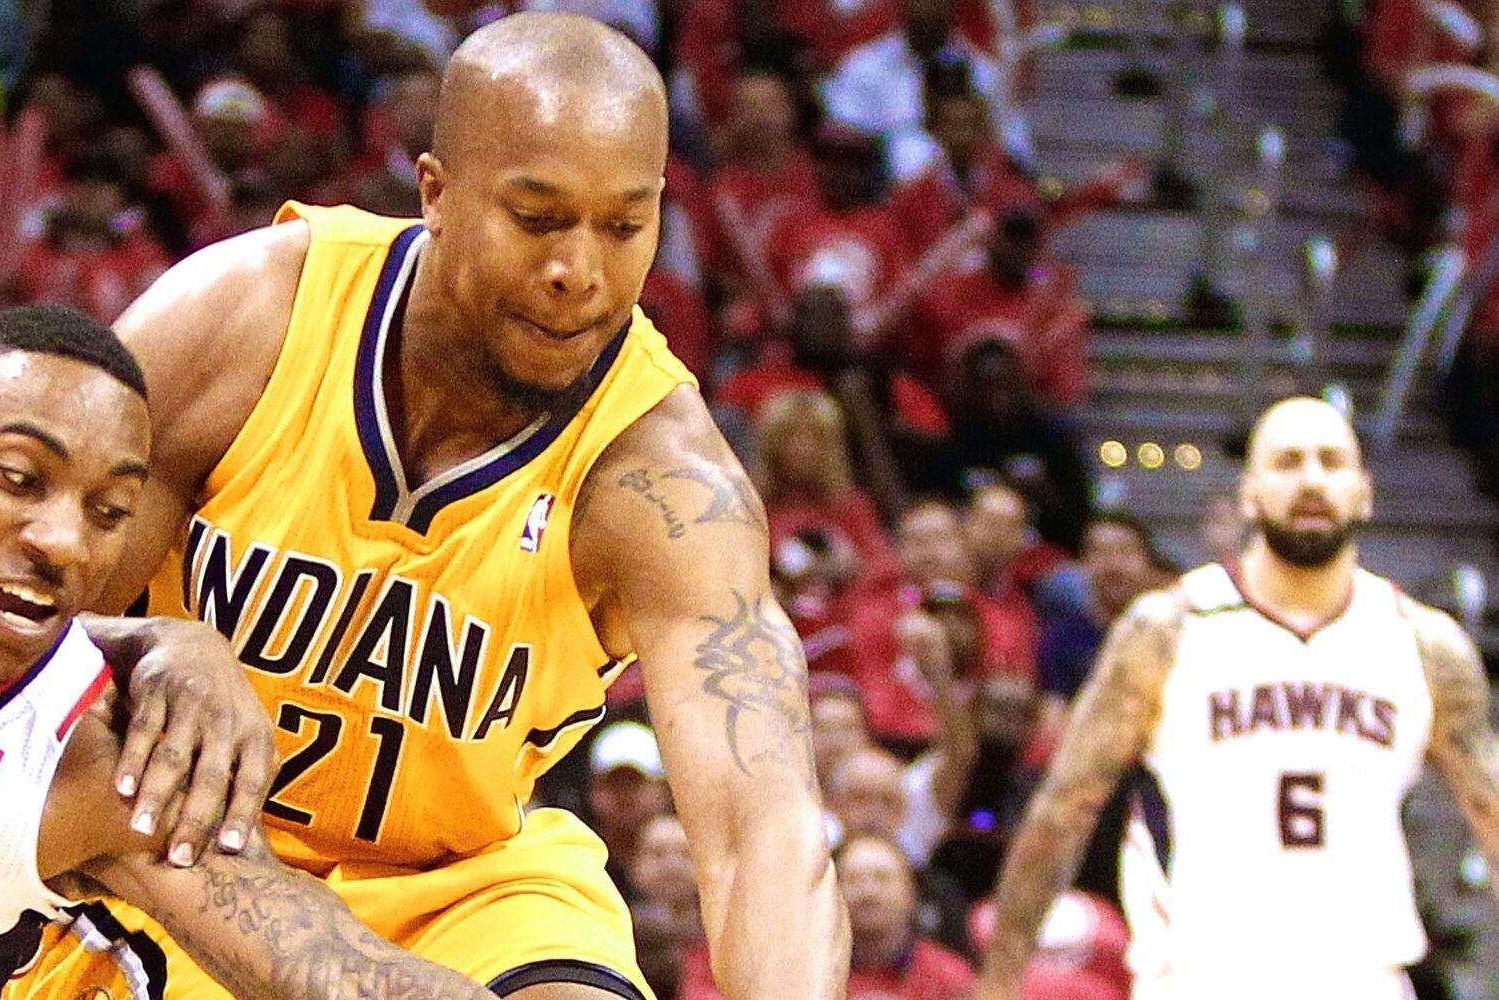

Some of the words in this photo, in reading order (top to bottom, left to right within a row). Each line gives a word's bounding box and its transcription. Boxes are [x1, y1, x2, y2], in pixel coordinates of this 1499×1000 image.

[182, 518, 533, 744] INDIANA
[1208, 682, 1398, 748] HAWKS
[262, 702, 406, 845] 21
[1276, 771, 1325, 849] 6
